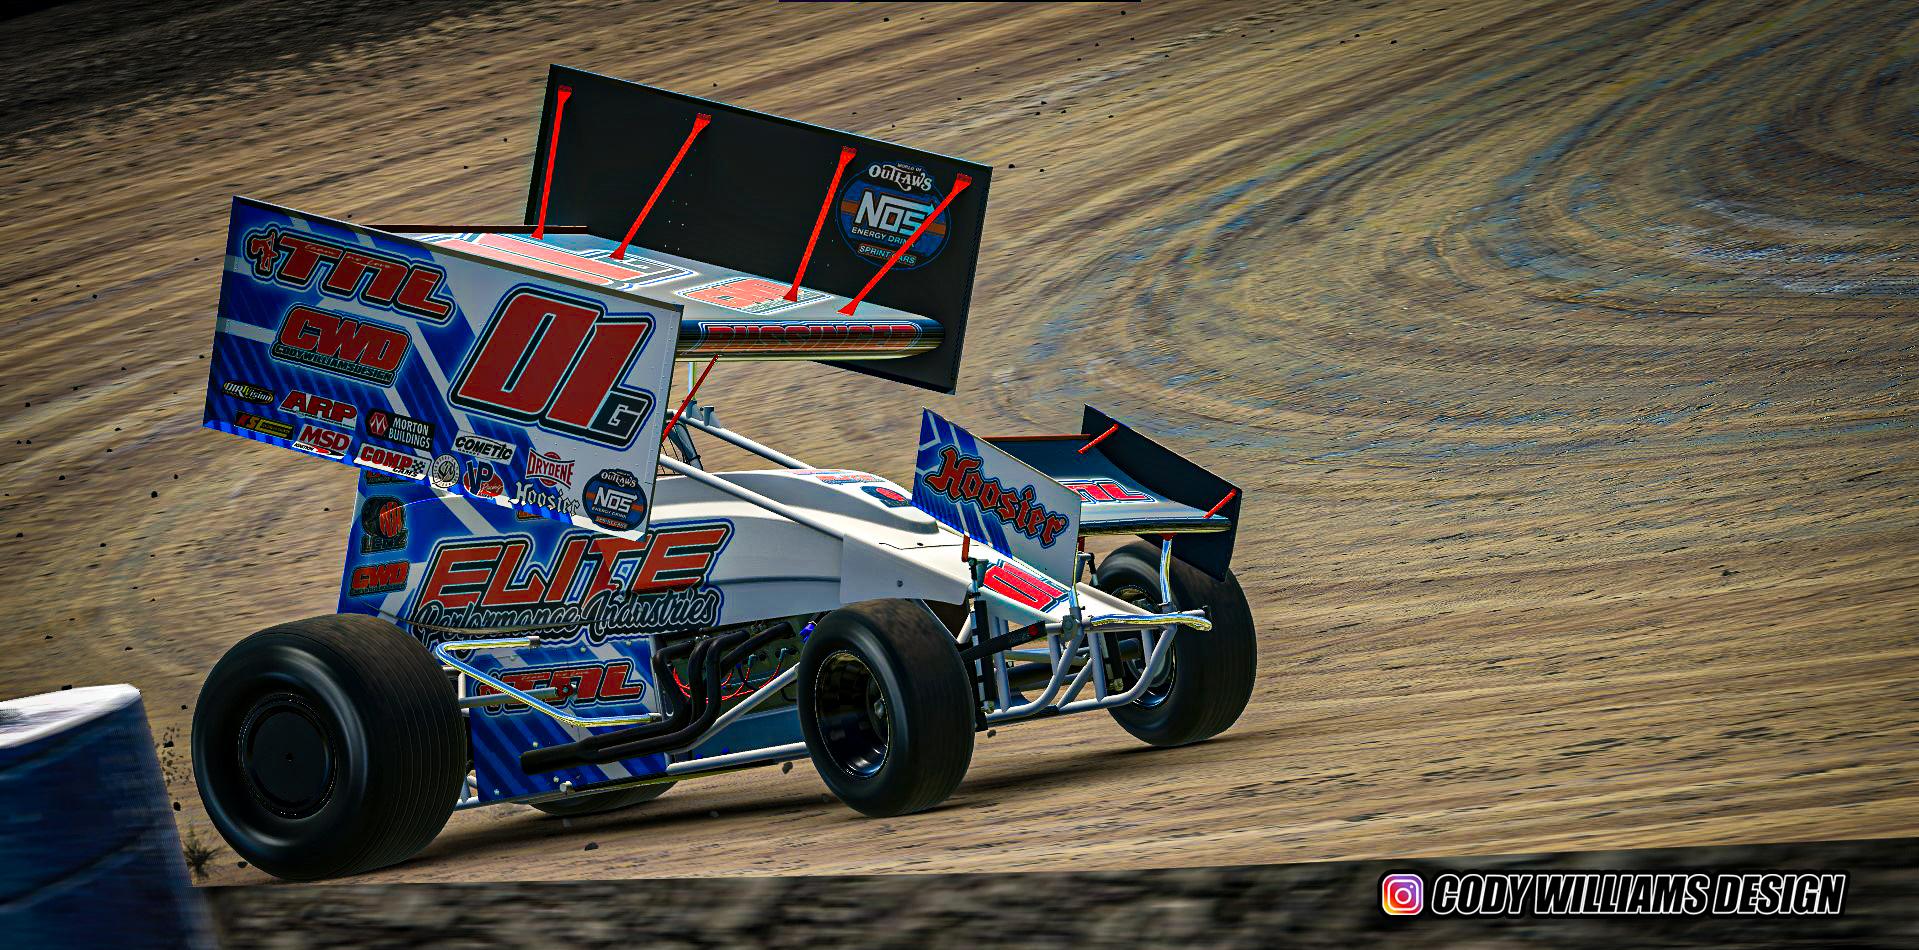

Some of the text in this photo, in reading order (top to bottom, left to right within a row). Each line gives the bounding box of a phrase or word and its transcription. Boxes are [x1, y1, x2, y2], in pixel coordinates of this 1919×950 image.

[854, 190, 934, 236] NOS
[851, 226, 886, 240] ENERGY
[859, 245, 891, 258] SPRINT
[280, 306, 408, 371] CWD
[280, 390, 357, 422] ARP
[300, 425, 351, 451] MSD
[388, 428, 430, 449] BUILDINGS
[392, 417, 429, 436] MORTON
[360, 445, 413, 471] COMP
[455, 436, 513, 460] COMETIC
[526, 454, 575, 486] DRYDENE
[508, 481, 580, 516] Hoosier
[594, 486, 637, 514] NOS
[927, 448, 1065, 544] Hoosier
[420, 529, 726, 608] ELITE
